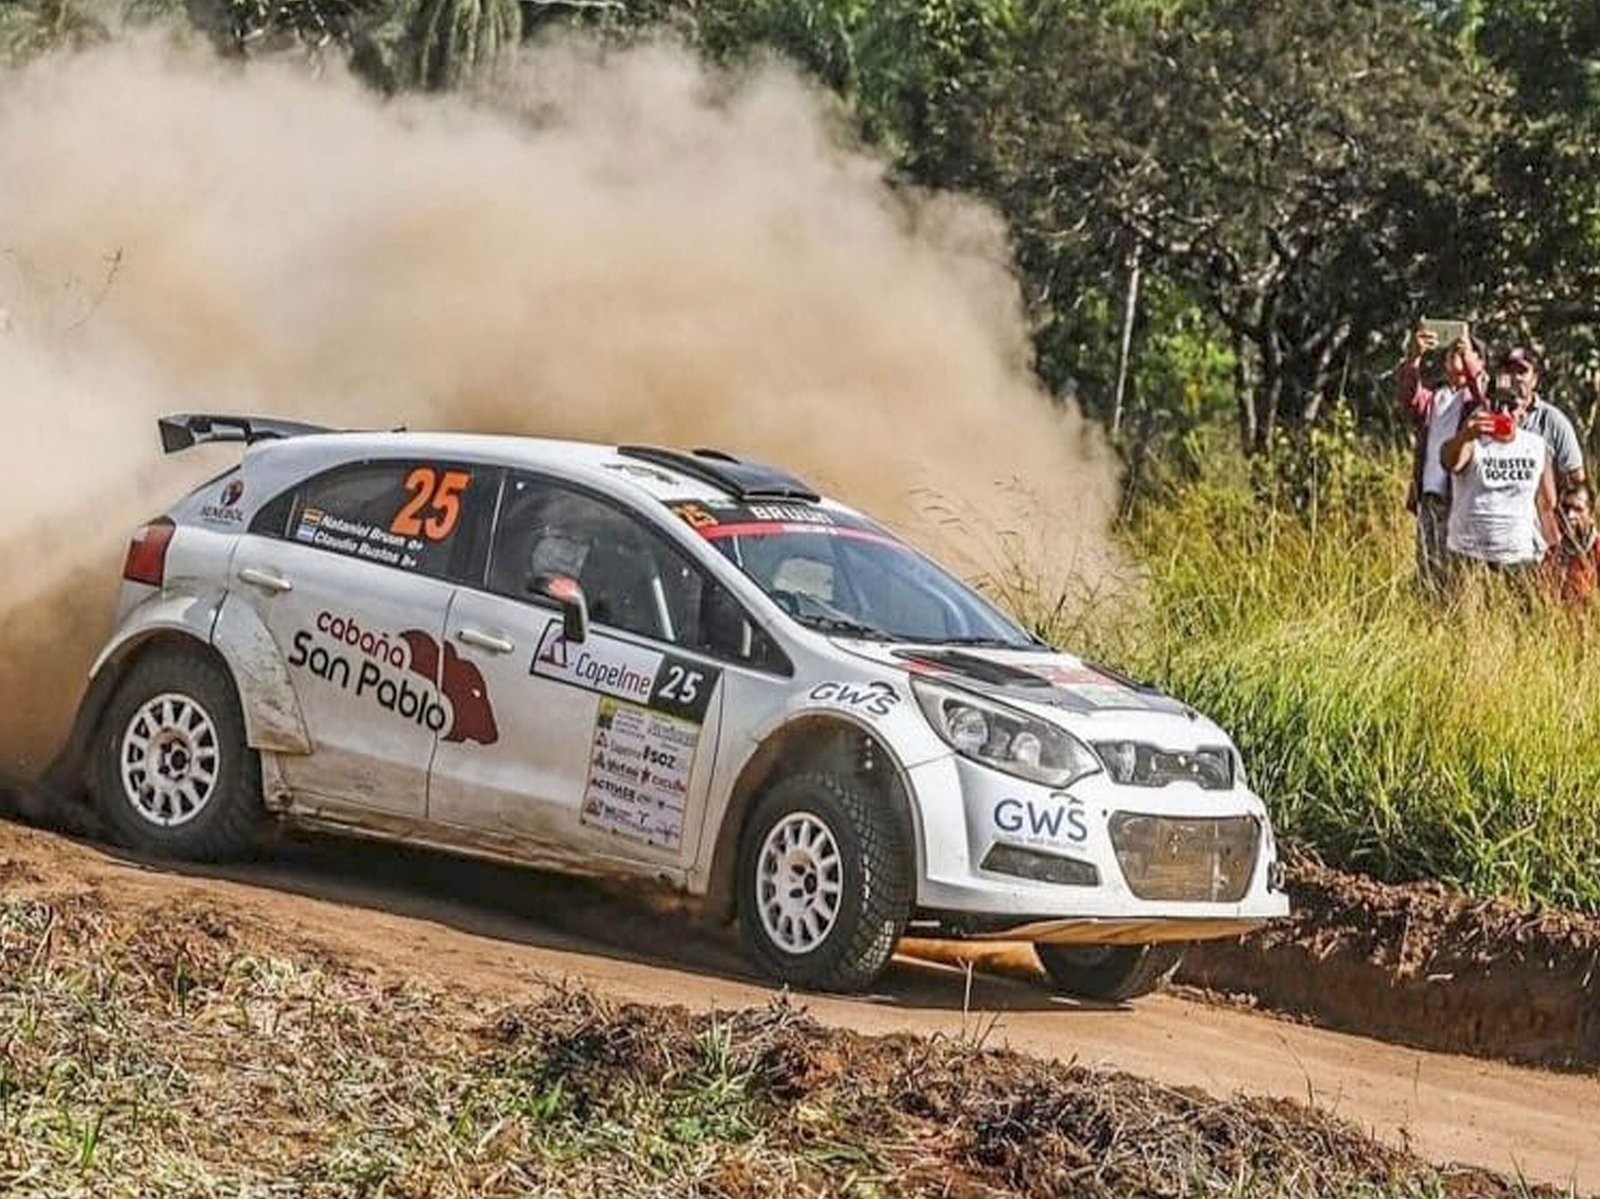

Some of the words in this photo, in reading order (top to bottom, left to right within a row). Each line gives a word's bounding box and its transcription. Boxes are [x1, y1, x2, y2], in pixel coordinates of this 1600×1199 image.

[1485, 468, 1533, 480] SOCCER
[390, 467, 473, 541] 25
[316, 611, 405, 669] cabaña
[288, 631, 350, 689] San
[355, 661, 446, 731] Pablo
[575, 652, 651, 696] Copelme
[658, 666, 703, 704] 25
[809, 682, 896, 716] GWS
[994, 798, 1088, 842] GWS
